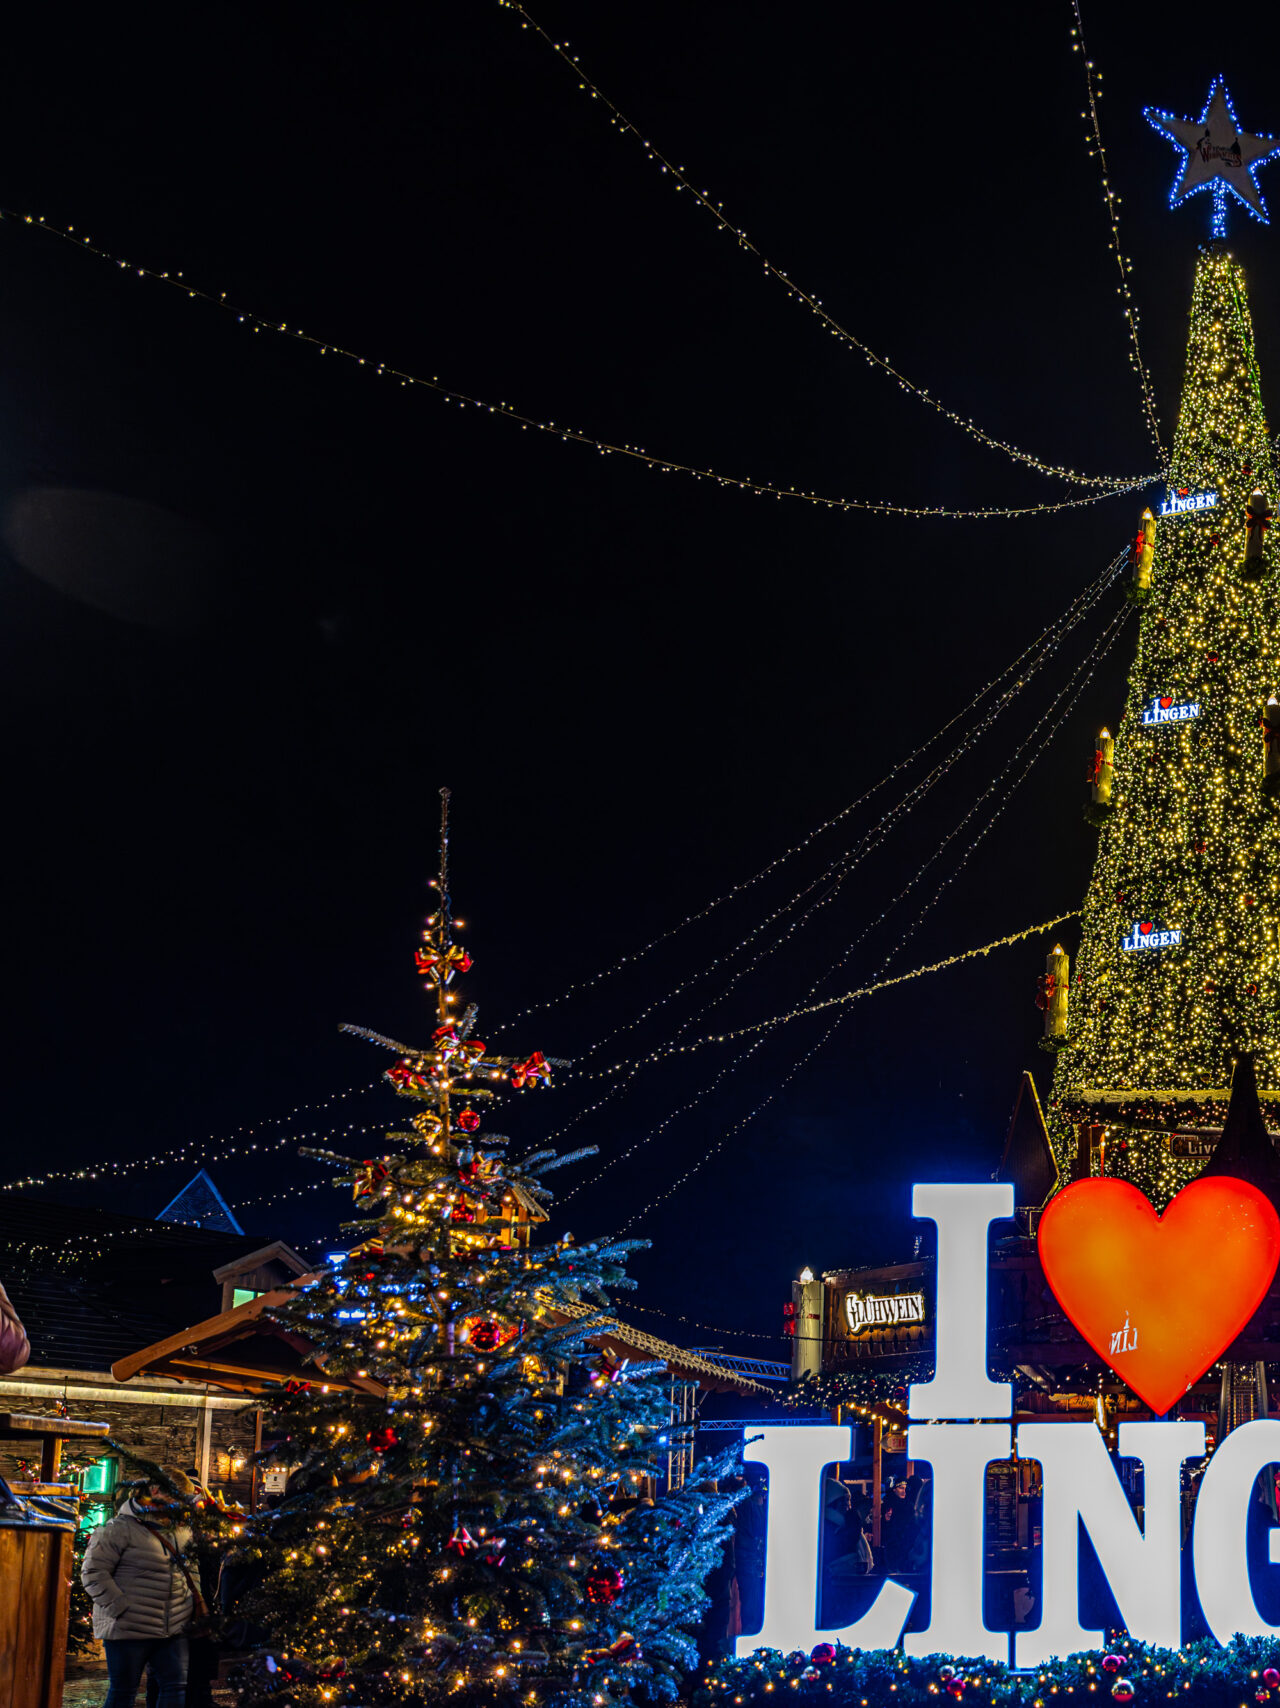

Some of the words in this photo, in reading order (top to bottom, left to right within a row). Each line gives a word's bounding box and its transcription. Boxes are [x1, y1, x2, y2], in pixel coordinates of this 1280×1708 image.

[1161, 493, 1216, 515] LINGEN
[1143, 703, 1200, 724] LINGEN
[1153, 698, 1161, 711] I
[1123, 930, 1181, 950] LINGEN
[1133, 923, 1140, 938] I
[908, 1183, 1015, 1419] I
[846, 1293, 923, 1331] GLÜHWEIN
